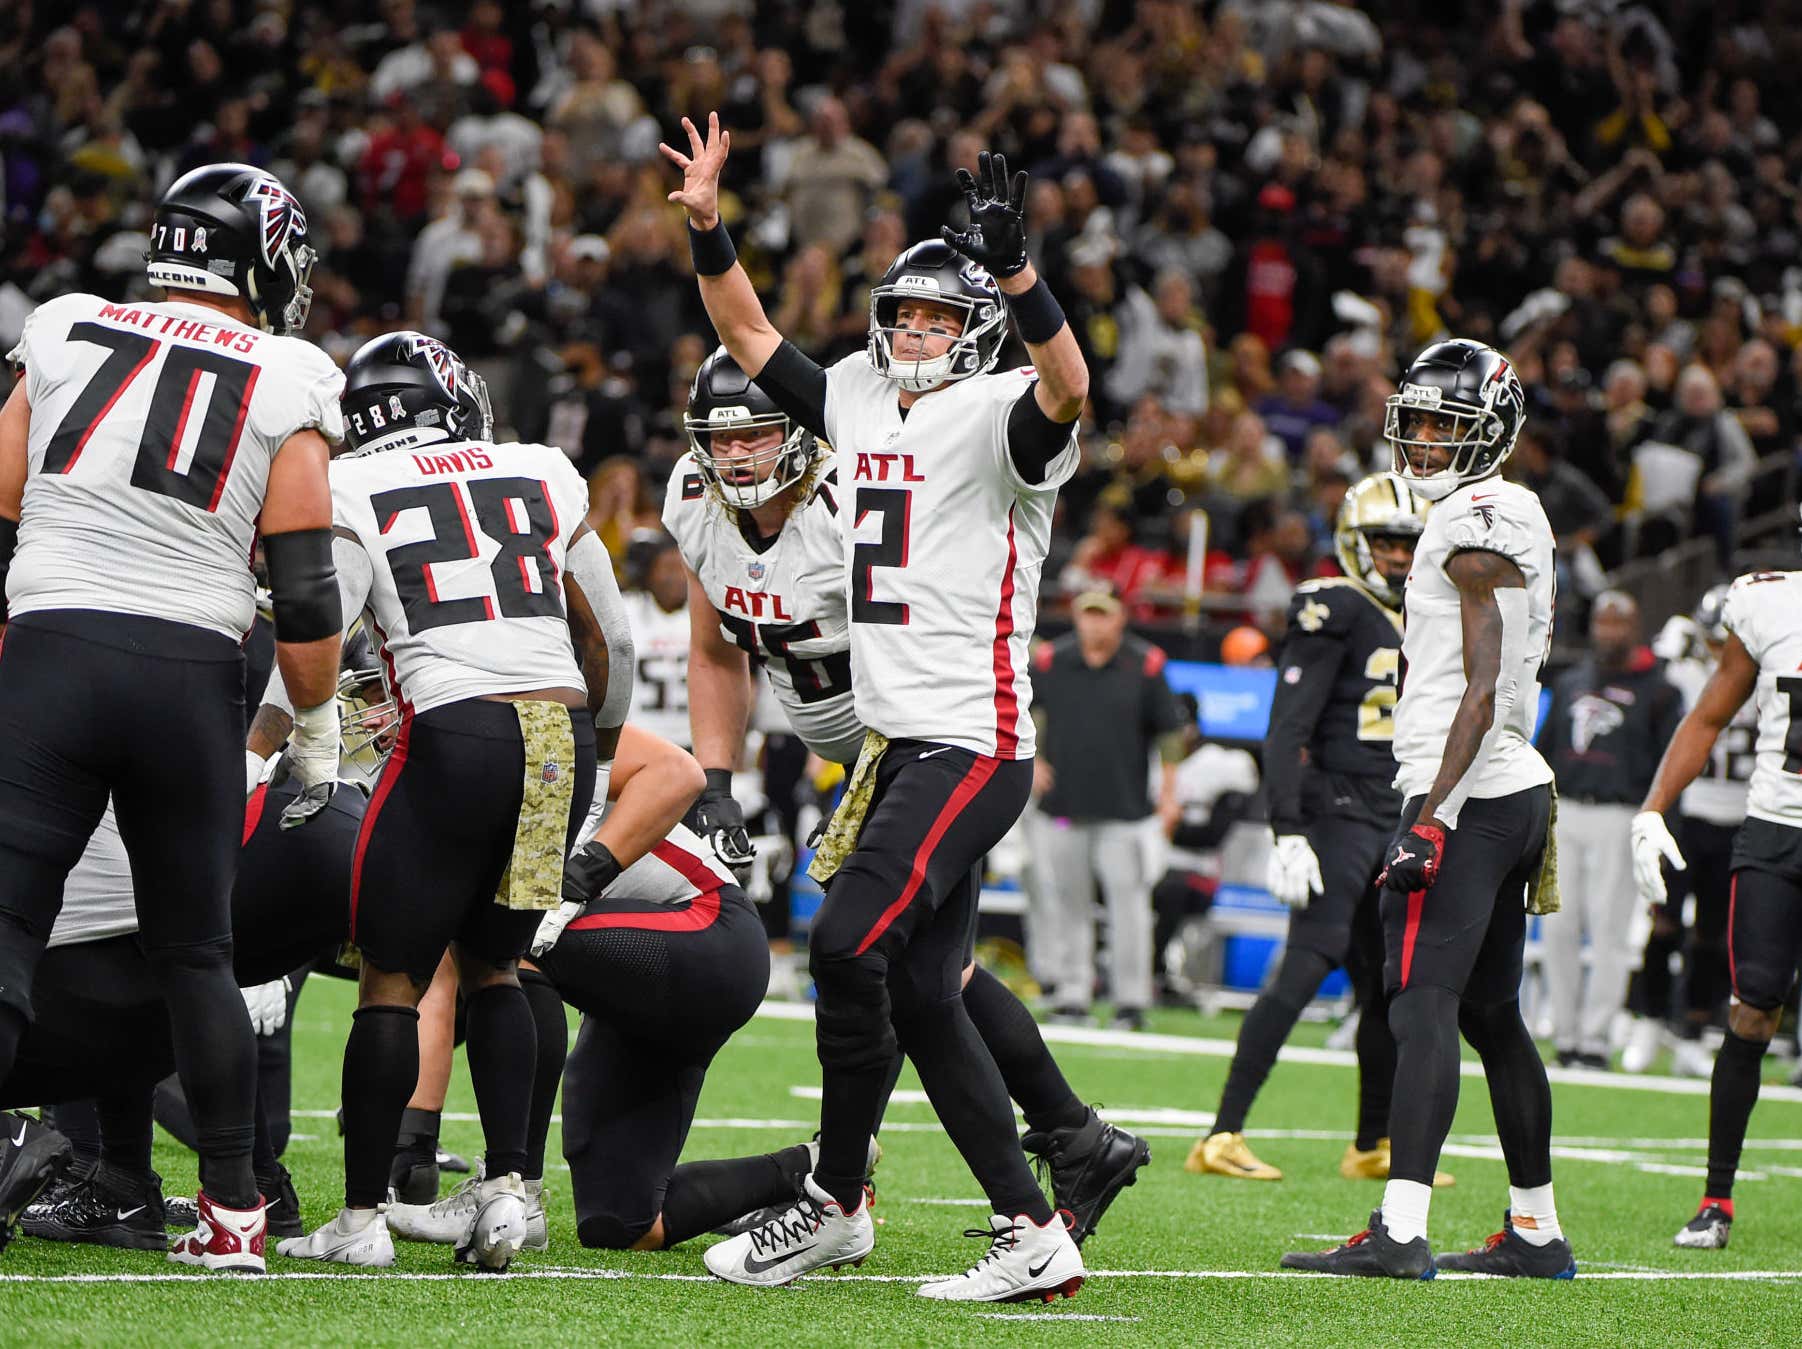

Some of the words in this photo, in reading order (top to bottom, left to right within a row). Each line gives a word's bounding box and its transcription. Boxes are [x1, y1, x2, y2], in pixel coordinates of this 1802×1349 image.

[158, 226, 188, 251] 70
[147, 271, 206, 285] ALCONS
[903, 276, 928, 286] ATL
[98, 303, 259, 353] MATTHEWS
[40, 321, 261, 513] 70
[352, 404, 386, 435] 28
[717, 409, 738, 418] ATL
[358, 435, 418, 458] LCONS
[411, 447, 494, 476] DAVIS
[852, 452, 925, 482] ATL
[369, 476, 568, 636] 28
[851, 487, 912, 626] 2
[724, 584, 793, 621] ATL
